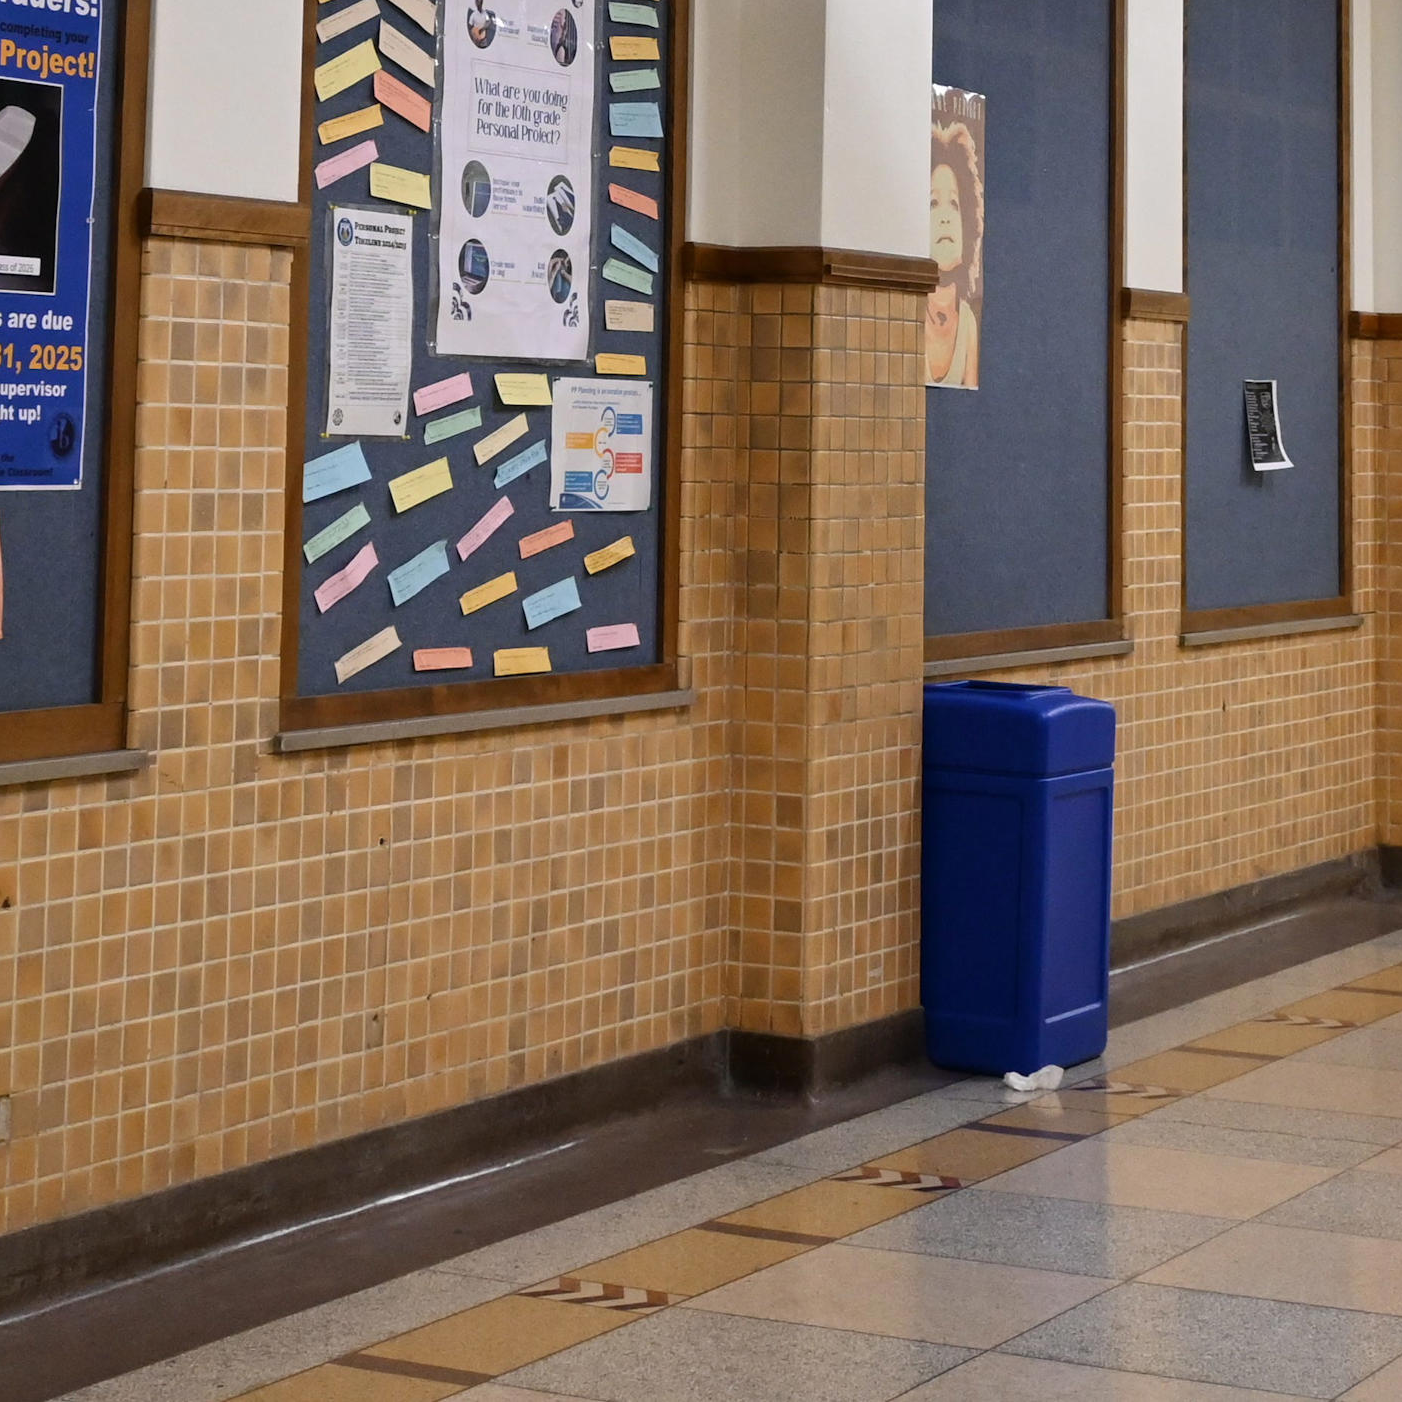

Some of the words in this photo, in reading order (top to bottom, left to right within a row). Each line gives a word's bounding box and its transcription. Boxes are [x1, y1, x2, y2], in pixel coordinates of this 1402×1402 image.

[0, 37, 96, 79] Project!
[476, 118, 520, 142] Personal
[7, 310, 37, 329] are
[41, 310, 74, 332] due
[28, 344, 84, 372] 2025
[17, 404, 43, 425] up!
